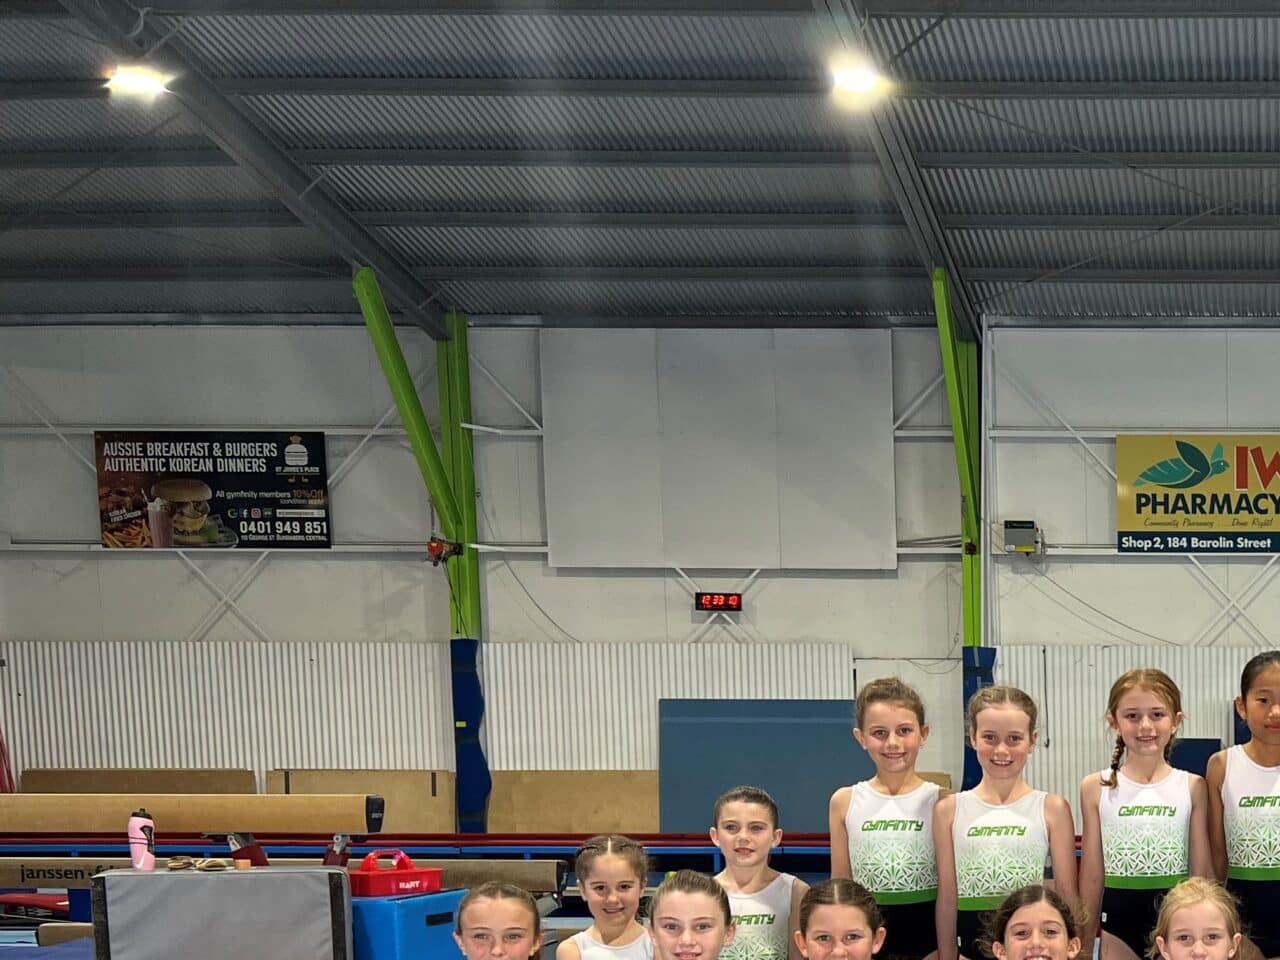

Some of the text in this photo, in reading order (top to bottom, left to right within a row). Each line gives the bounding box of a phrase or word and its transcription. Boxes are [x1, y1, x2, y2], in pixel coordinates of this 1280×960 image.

[104, 442, 277, 457] AUSSIE BREAKFAST & BURGERS
[104, 459, 166, 472] AUTHENTIC
[169, 459, 213, 472] KOREAN
[217, 459, 266, 472] DINNERS
[240, 522, 327, 534] 0401 949 851
[1122, 537, 1152, 550] Shop
[1168, 537, 1187, 548] 184
[1191, 537, 1234, 548] Barolin
[1237, 537, 1272, 548] Street
[1118, 804, 1176, 818] GYMFINITY
[862, 820, 924, 833] GYMFINITY
[966, 824, 1026, 838] GYMFINITY
[20, 864, 85, 883] janssen
[733, 914, 776, 926] MFINITY
